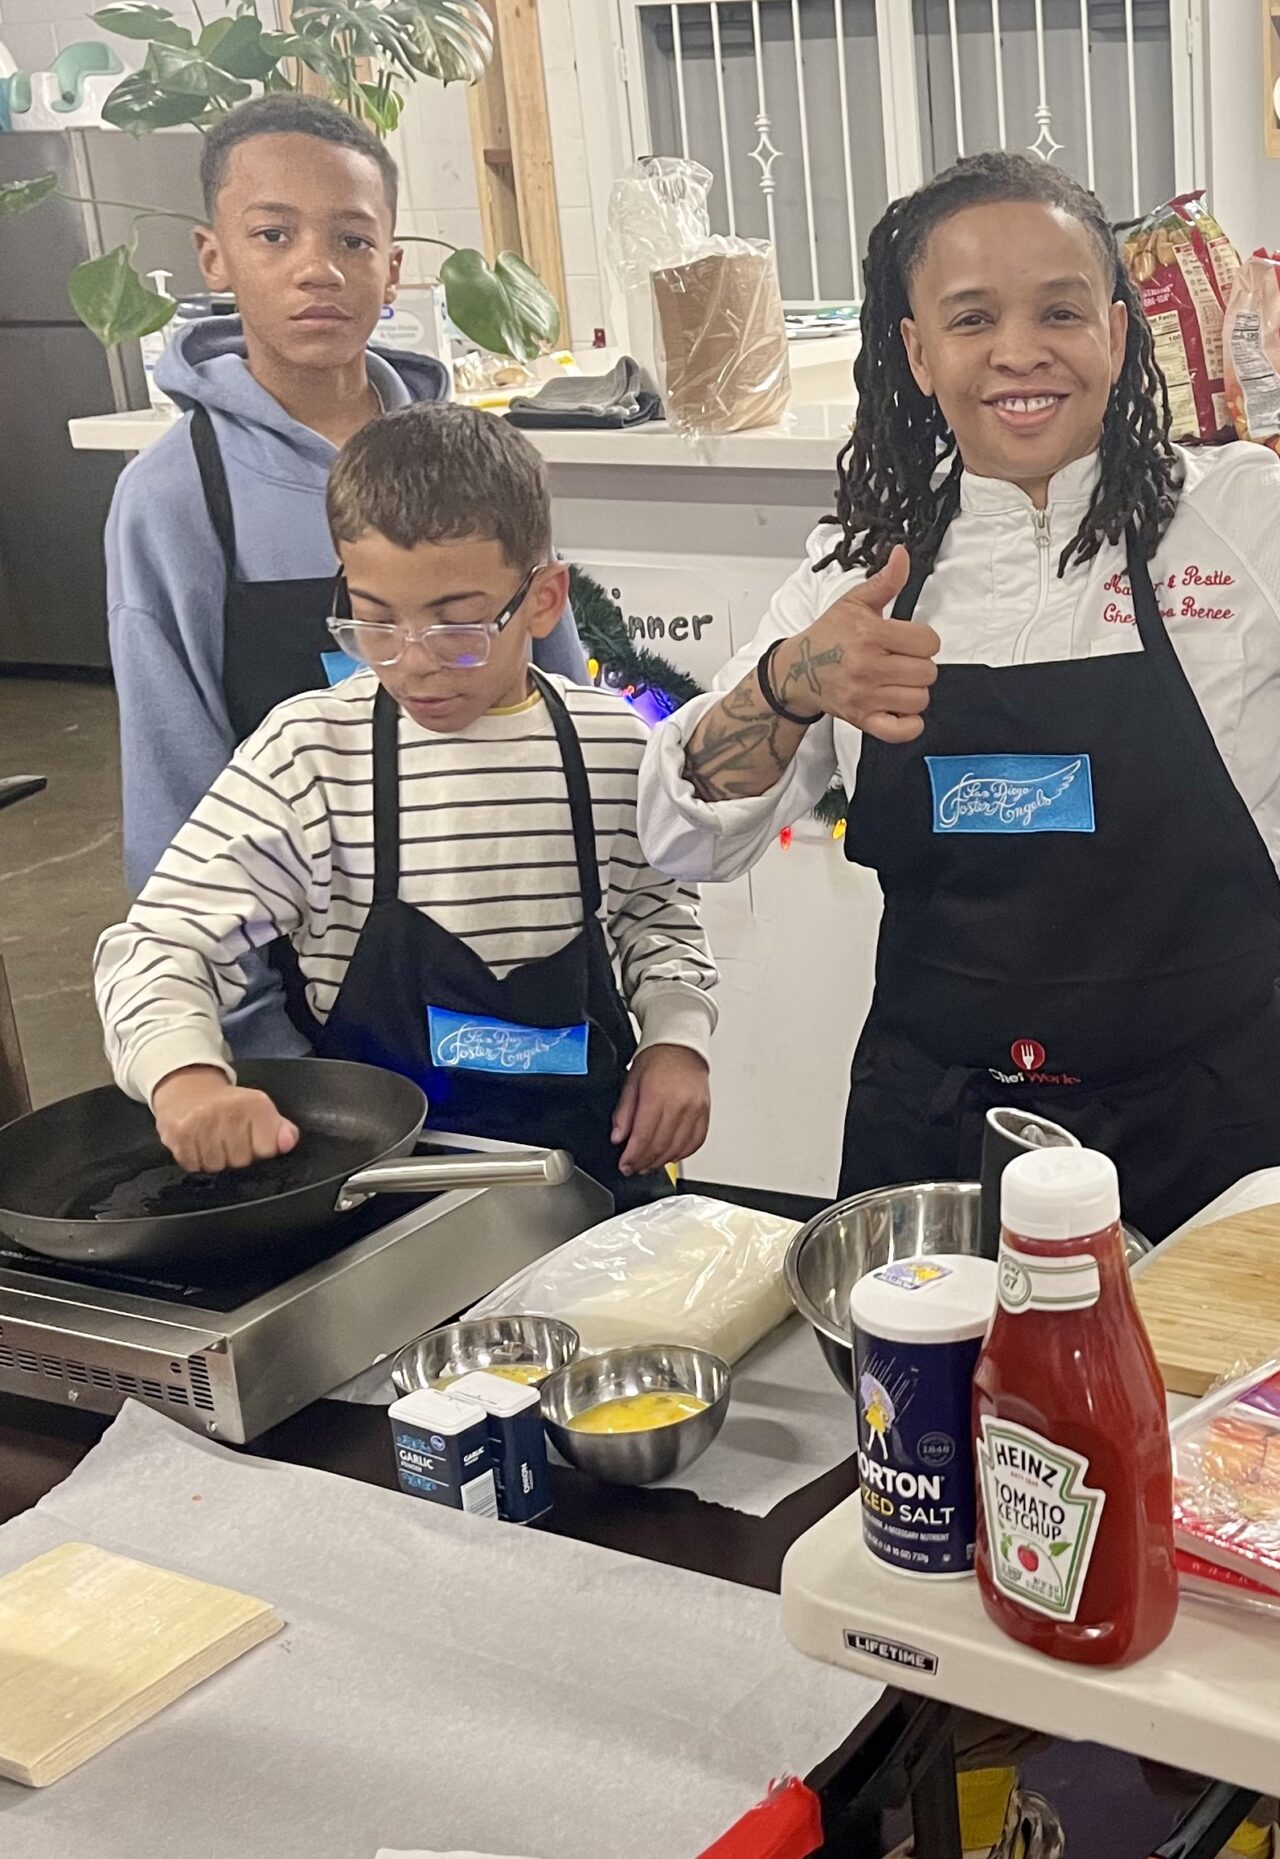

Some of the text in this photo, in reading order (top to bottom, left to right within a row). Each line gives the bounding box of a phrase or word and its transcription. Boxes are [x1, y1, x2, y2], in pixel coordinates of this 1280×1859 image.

[1182, 565, 1236, 586] Pestle
[611, 587, 713, 641] inner
[1103, 603, 1137, 626] Che
[1181, 596, 1235, 619] Renee
[963, 782, 1033, 801] San Diego
[997, 791, 1051, 827] Angels
[399, 1449, 435, 1470] GARLIC
[859, 1451, 941, 1501] ORTON
[994, 1443, 1059, 1489] HEINZ
[861, 1483, 894, 1518] ZED
[900, 1504, 955, 1526] SALT
[994, 1475, 1066, 1526] TOMATO
[998, 1503, 1063, 1542] KETCHUP
[855, 1635, 926, 1669] LIFETIME
